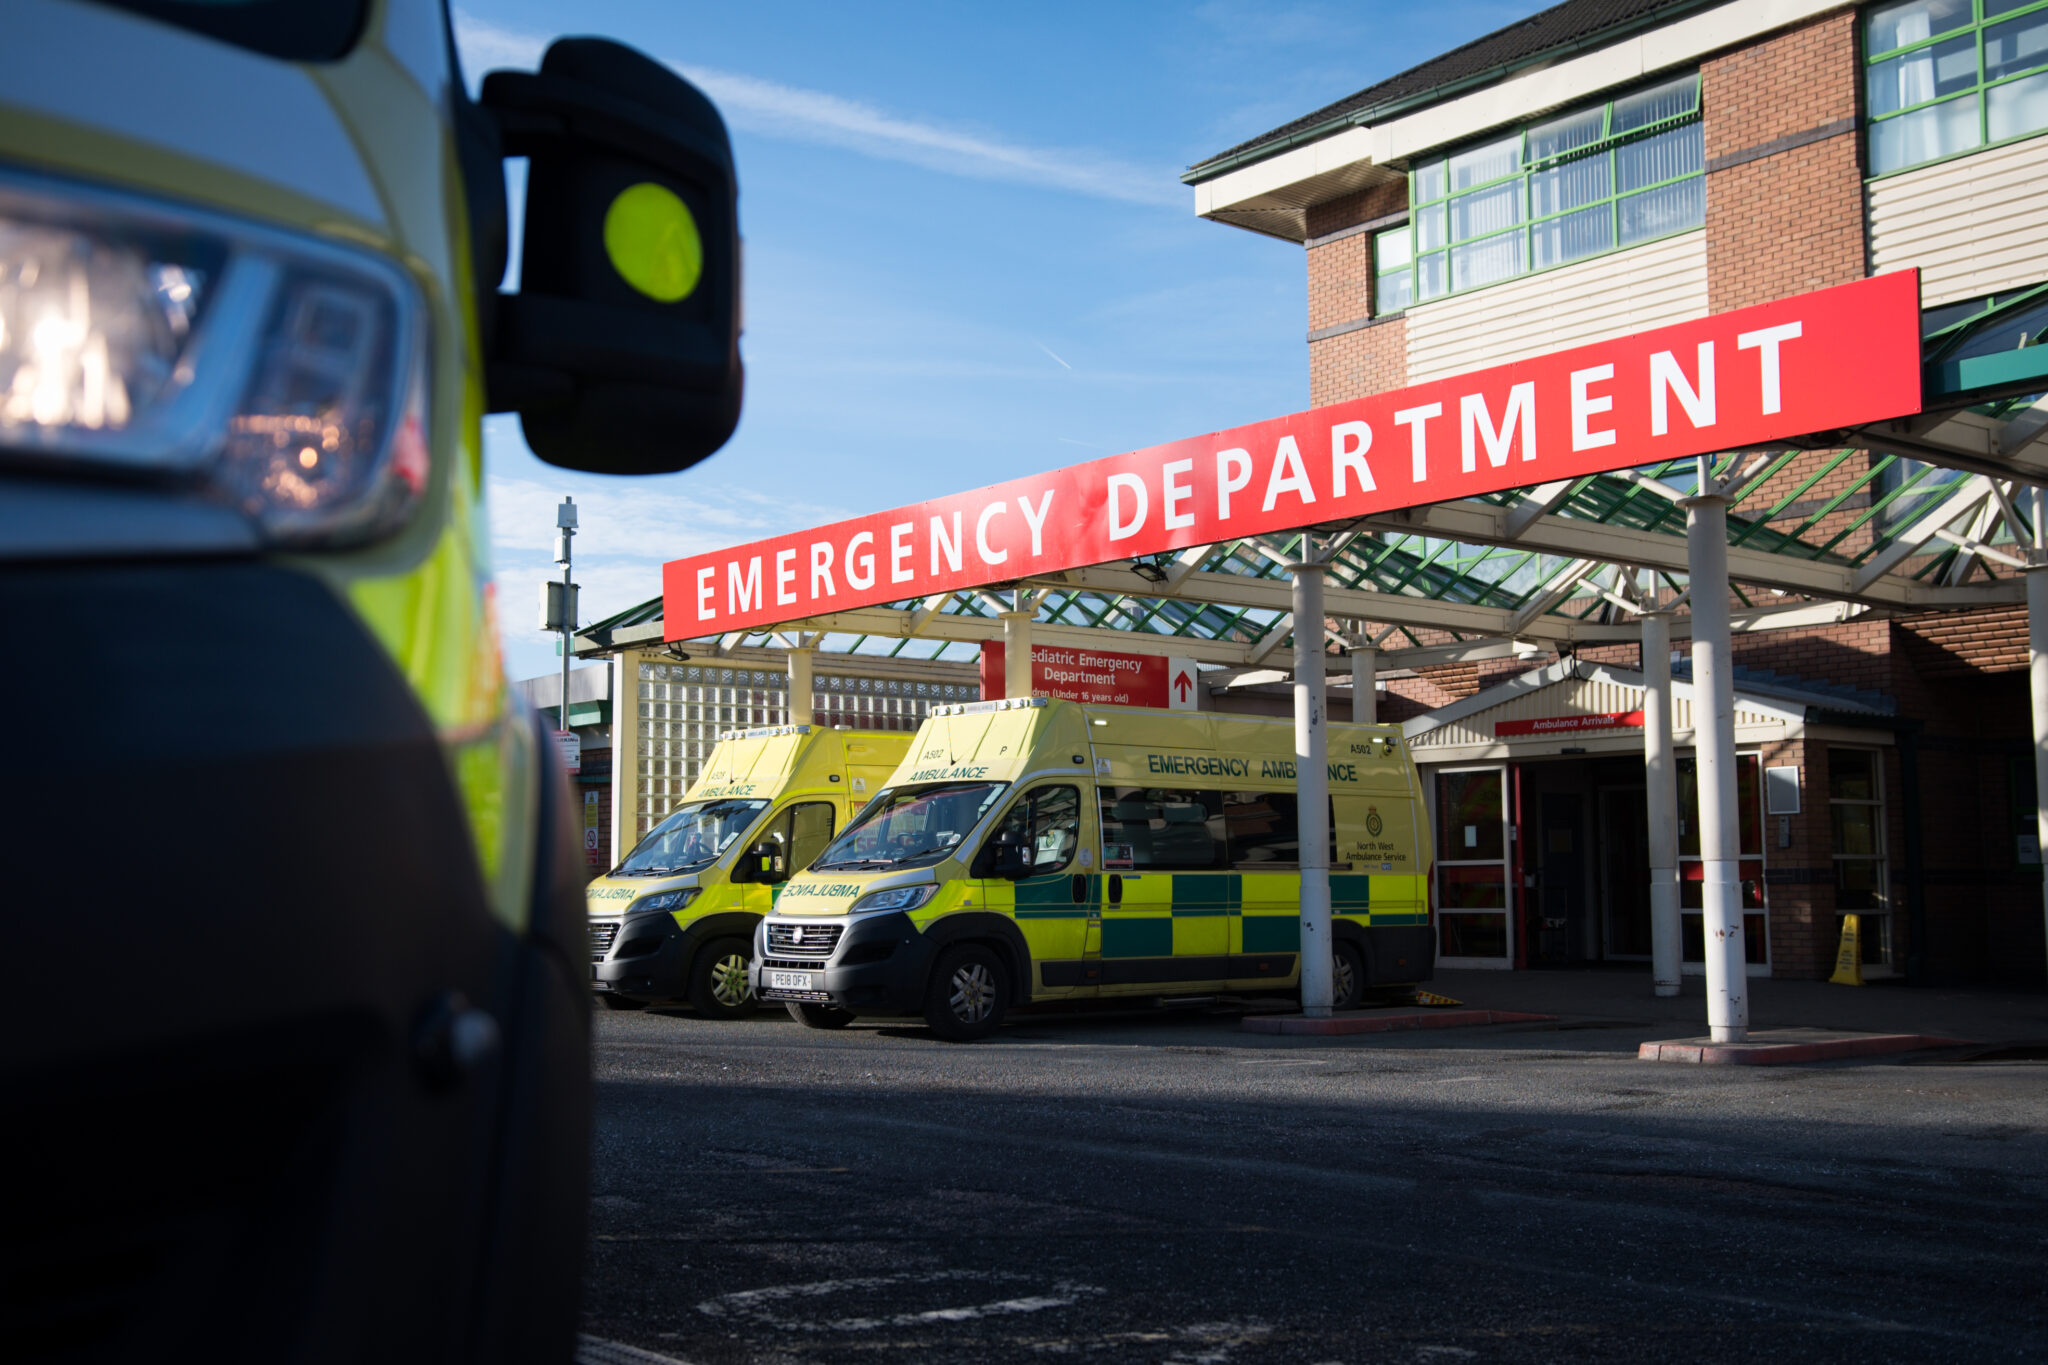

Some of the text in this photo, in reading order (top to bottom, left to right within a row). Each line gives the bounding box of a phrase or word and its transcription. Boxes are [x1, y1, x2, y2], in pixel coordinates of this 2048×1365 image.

[696, 320, 1803, 622] EMERGENCY DEPARTMENT
[1031, 649, 1142, 673] ediatric Emergency
[1044, 667, 1116, 685] Department
[1032, 687, 1129, 704] dren (Under 16 years old)
[1532, 715, 1615, 730] Ambulance Arrivals
[923, 749, 945, 761] A502
[1000, 745, 1008, 756] P
[1350, 744, 1372, 755] A502
[910, 766, 989, 782] AMBULANCE
[1148, 754, 1359, 782] EMERGENCY AMBNCE
[698, 784, 757, 798] AMBULANCE
[1357, 841, 1395, 851] North West
[1346, 852, 1407, 862] Ambulance Service
[775, 974, 807, 987] PE18 OFX
